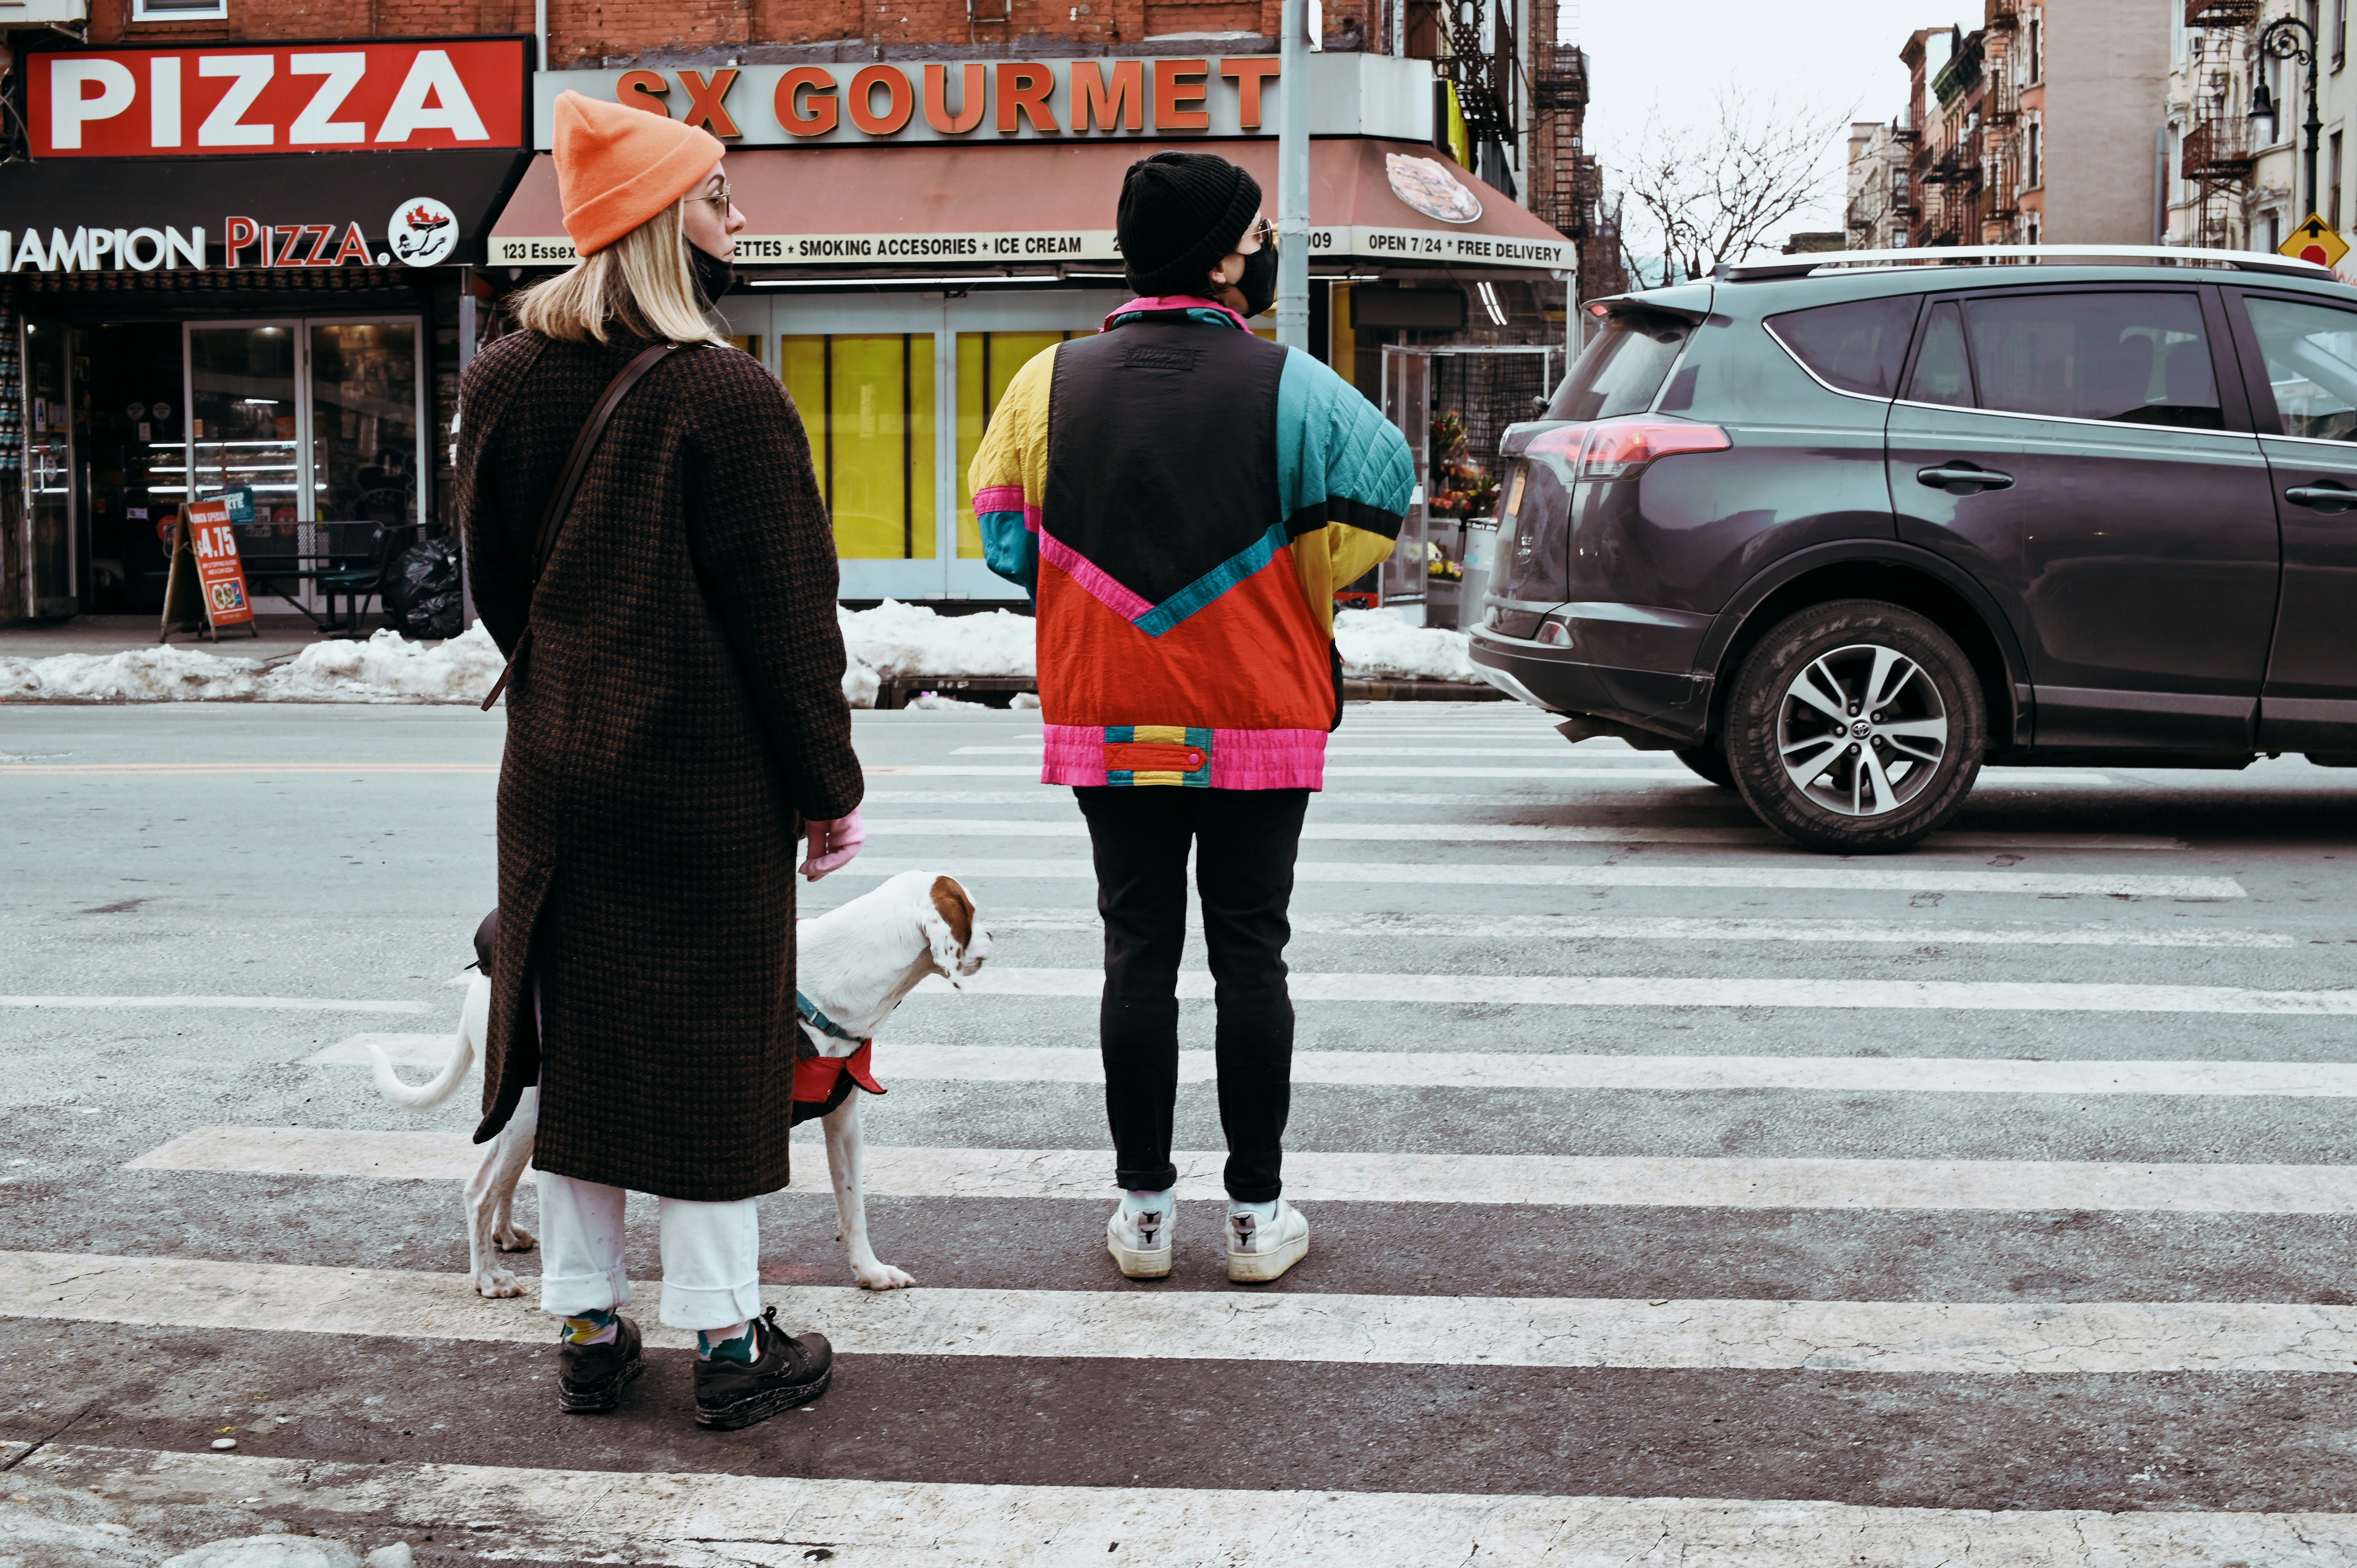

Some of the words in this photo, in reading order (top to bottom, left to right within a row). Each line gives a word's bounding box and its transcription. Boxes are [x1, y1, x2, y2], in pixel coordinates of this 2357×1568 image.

[51, 50, 490, 149] PIZZA
[774, 58, 1281, 137] GOURMET
[0, 225, 205, 273] AMPION
[226, 216, 373, 269] PIZZA
[503, 243, 526, 259] 123
[532, 243, 576, 259] Essex
[800, 240, 871, 256] SMOKING
[877, 238, 977, 256] ACCESORIES
[994, 237, 1019, 254] ICE
[1025, 237, 1081, 253] CREAM
[1308, 232, 1332, 248] 09
[1369, 235, 1406, 251] OPEN
[1411, 237, 1442, 253] 7/24
[1457, 240, 1491, 257] FREE
[1496, 243, 1562, 262] DELIVERY
[196, 526, 237, 558] $4.75
